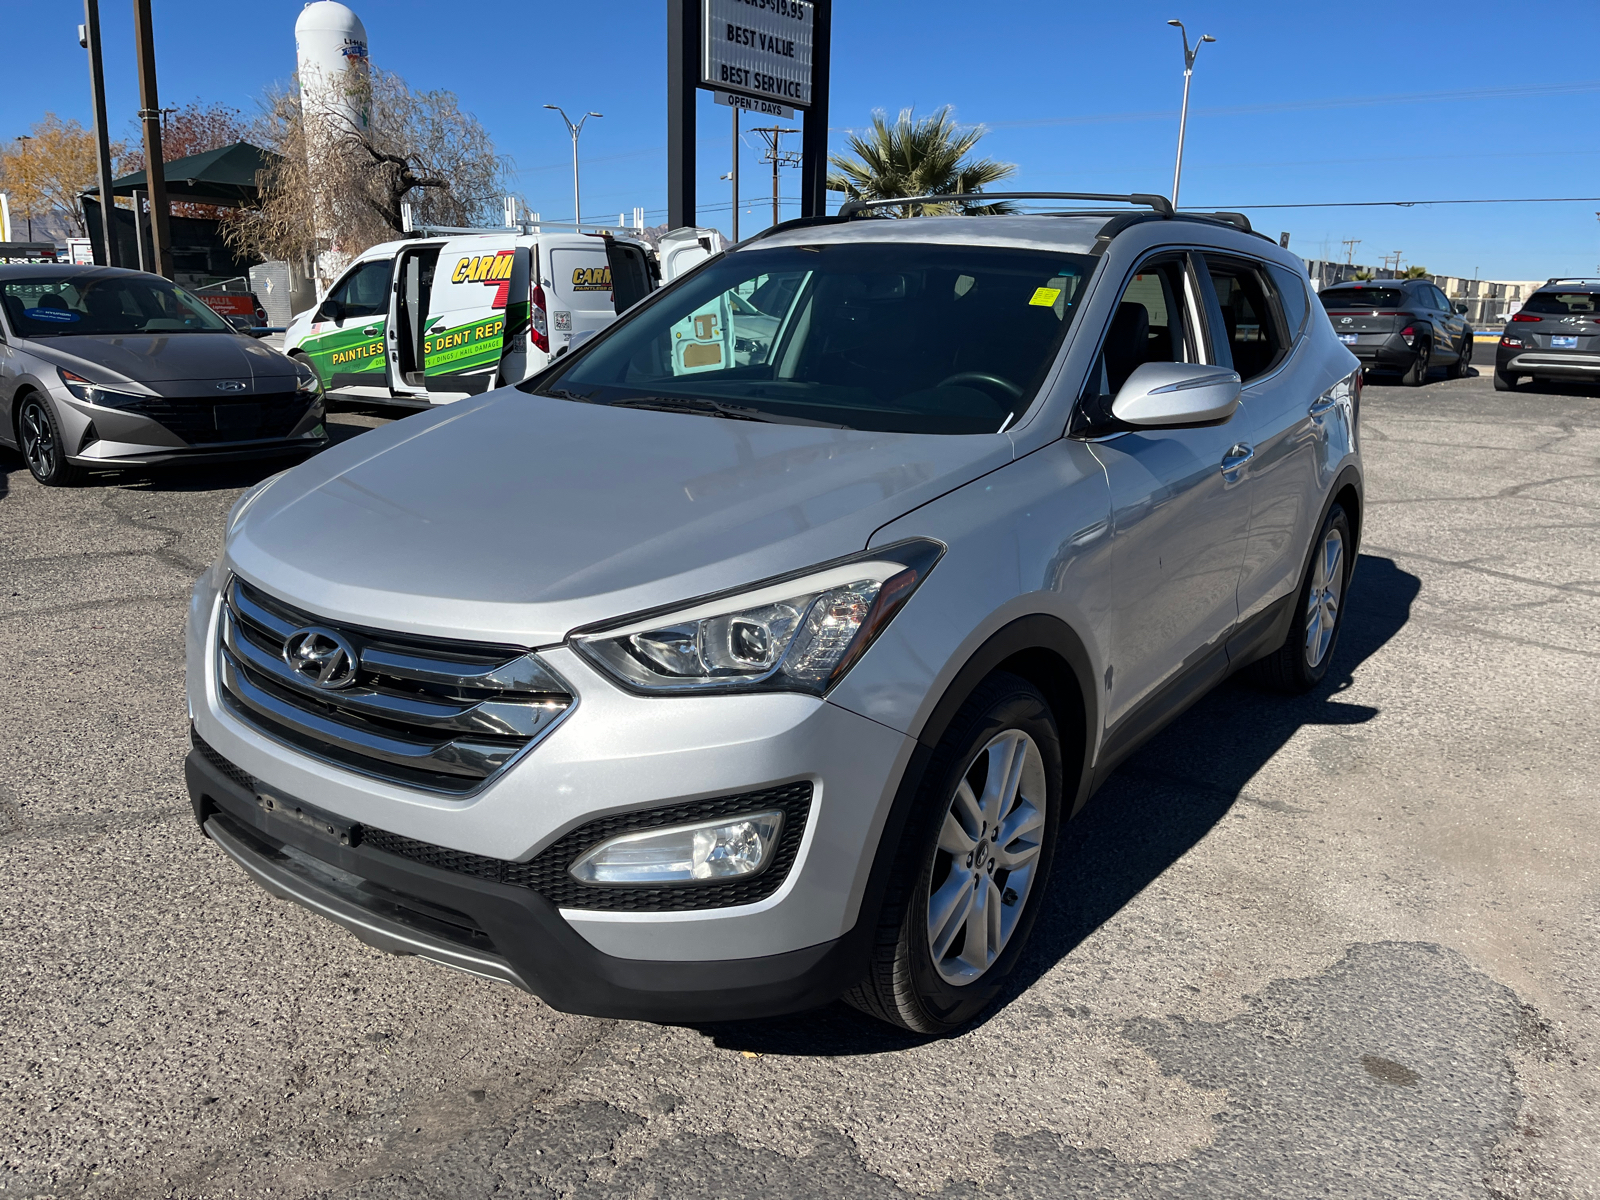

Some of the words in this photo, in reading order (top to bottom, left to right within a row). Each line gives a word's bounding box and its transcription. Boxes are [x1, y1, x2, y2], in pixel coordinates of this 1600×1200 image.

[727, 24, 756, 47] BEST
[759, 32, 794, 58] VALUE
[721, 64, 749, 86] BEST
[754, 72, 800, 98] SERVICE
[728, 95, 751, 109] OPEN
[754, 101, 759, 110] 7
[761, 103, 782, 115] DAYS
[436, 330, 471, 351] DENT
[475, 321, 504, 340] REP
[332, 342, 384, 365] PAINTLES
[437, 353, 454, 363] DINGS
[460, 348, 473, 356] HAIL
[475, 340, 499, 352] DAMAGE
